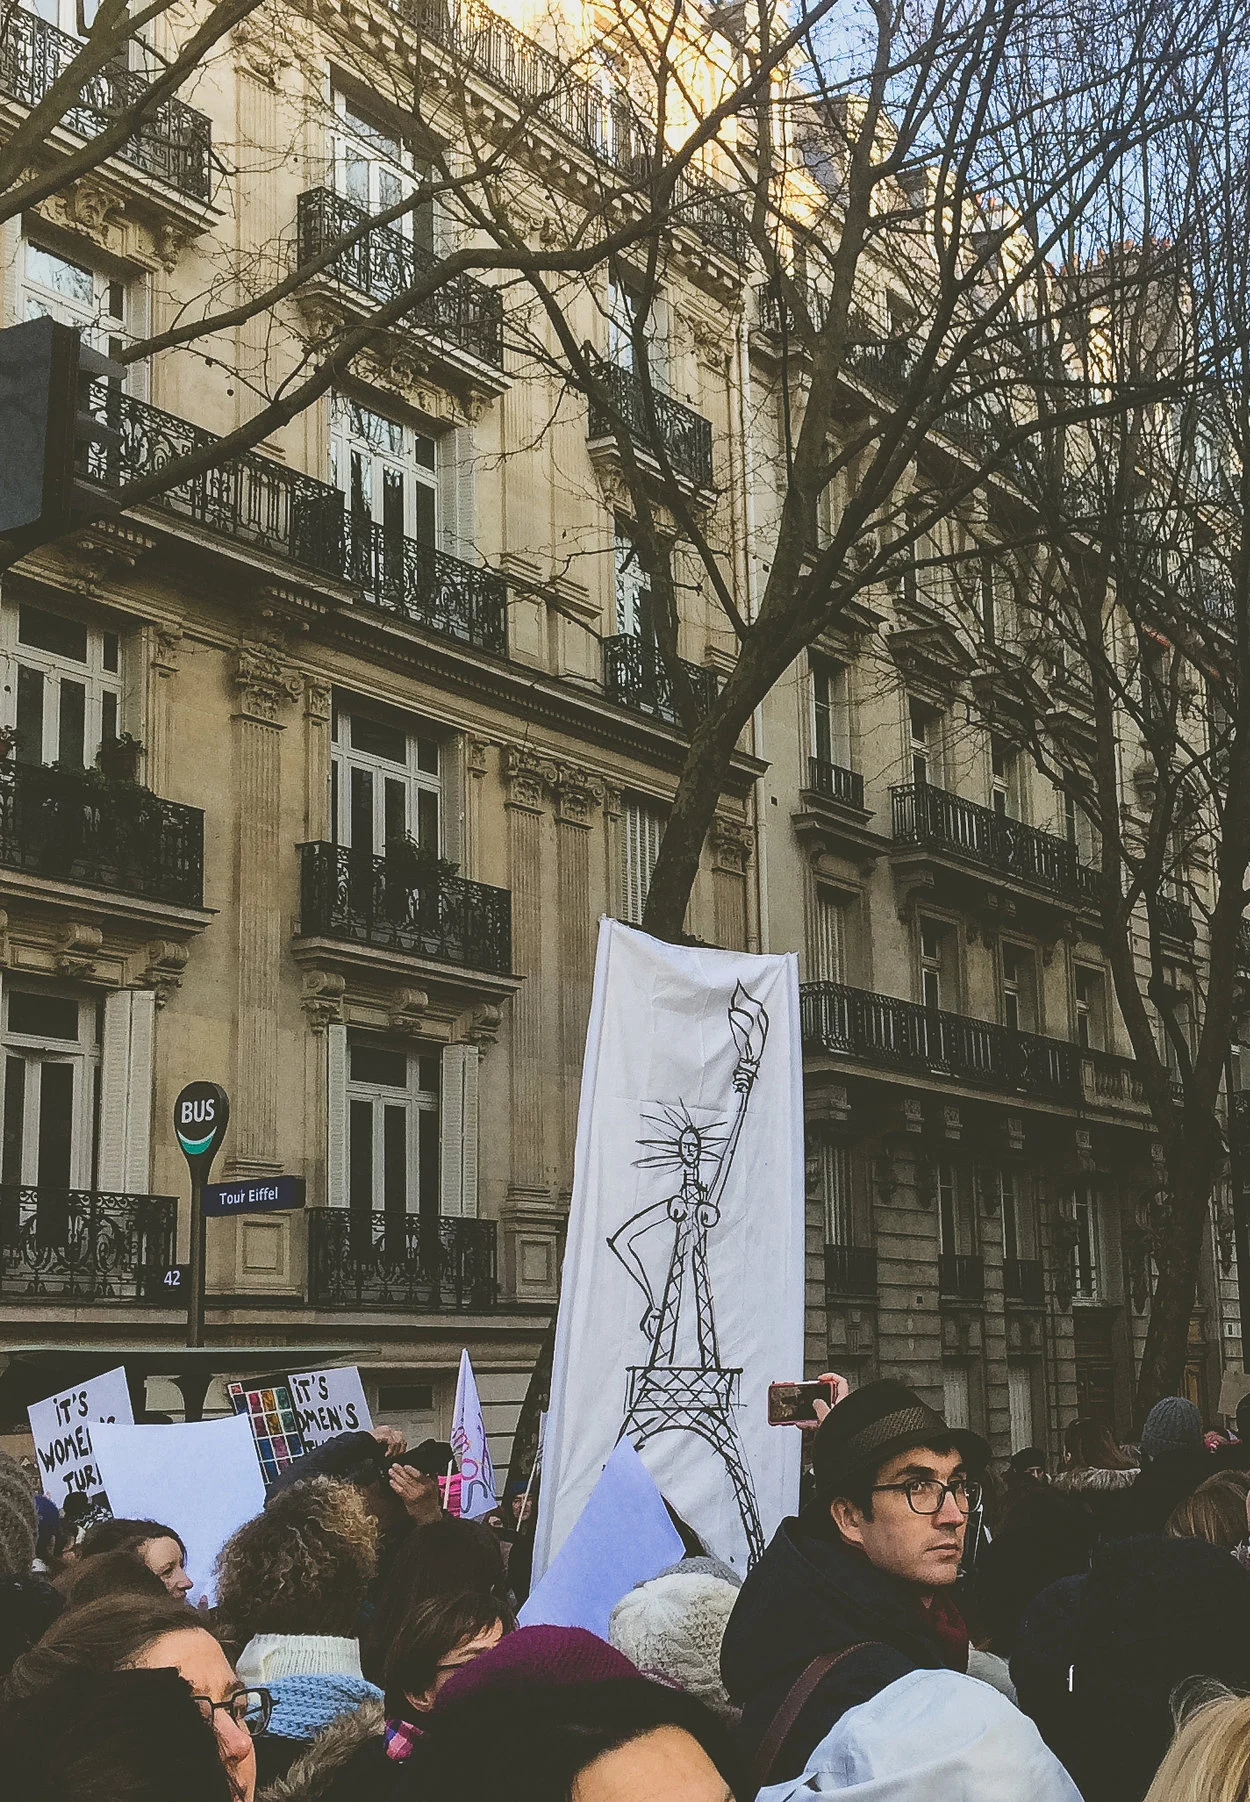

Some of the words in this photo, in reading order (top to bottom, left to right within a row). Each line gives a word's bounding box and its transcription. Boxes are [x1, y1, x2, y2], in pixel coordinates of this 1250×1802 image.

[181, 1098, 215, 1124] BUS
[219, 1190, 245, 1205] Tour
[249, 1186, 279, 1203] Eiffel
[164, 1270, 181, 1286] 42
[297, 1403, 359, 1433] OMEN'S
